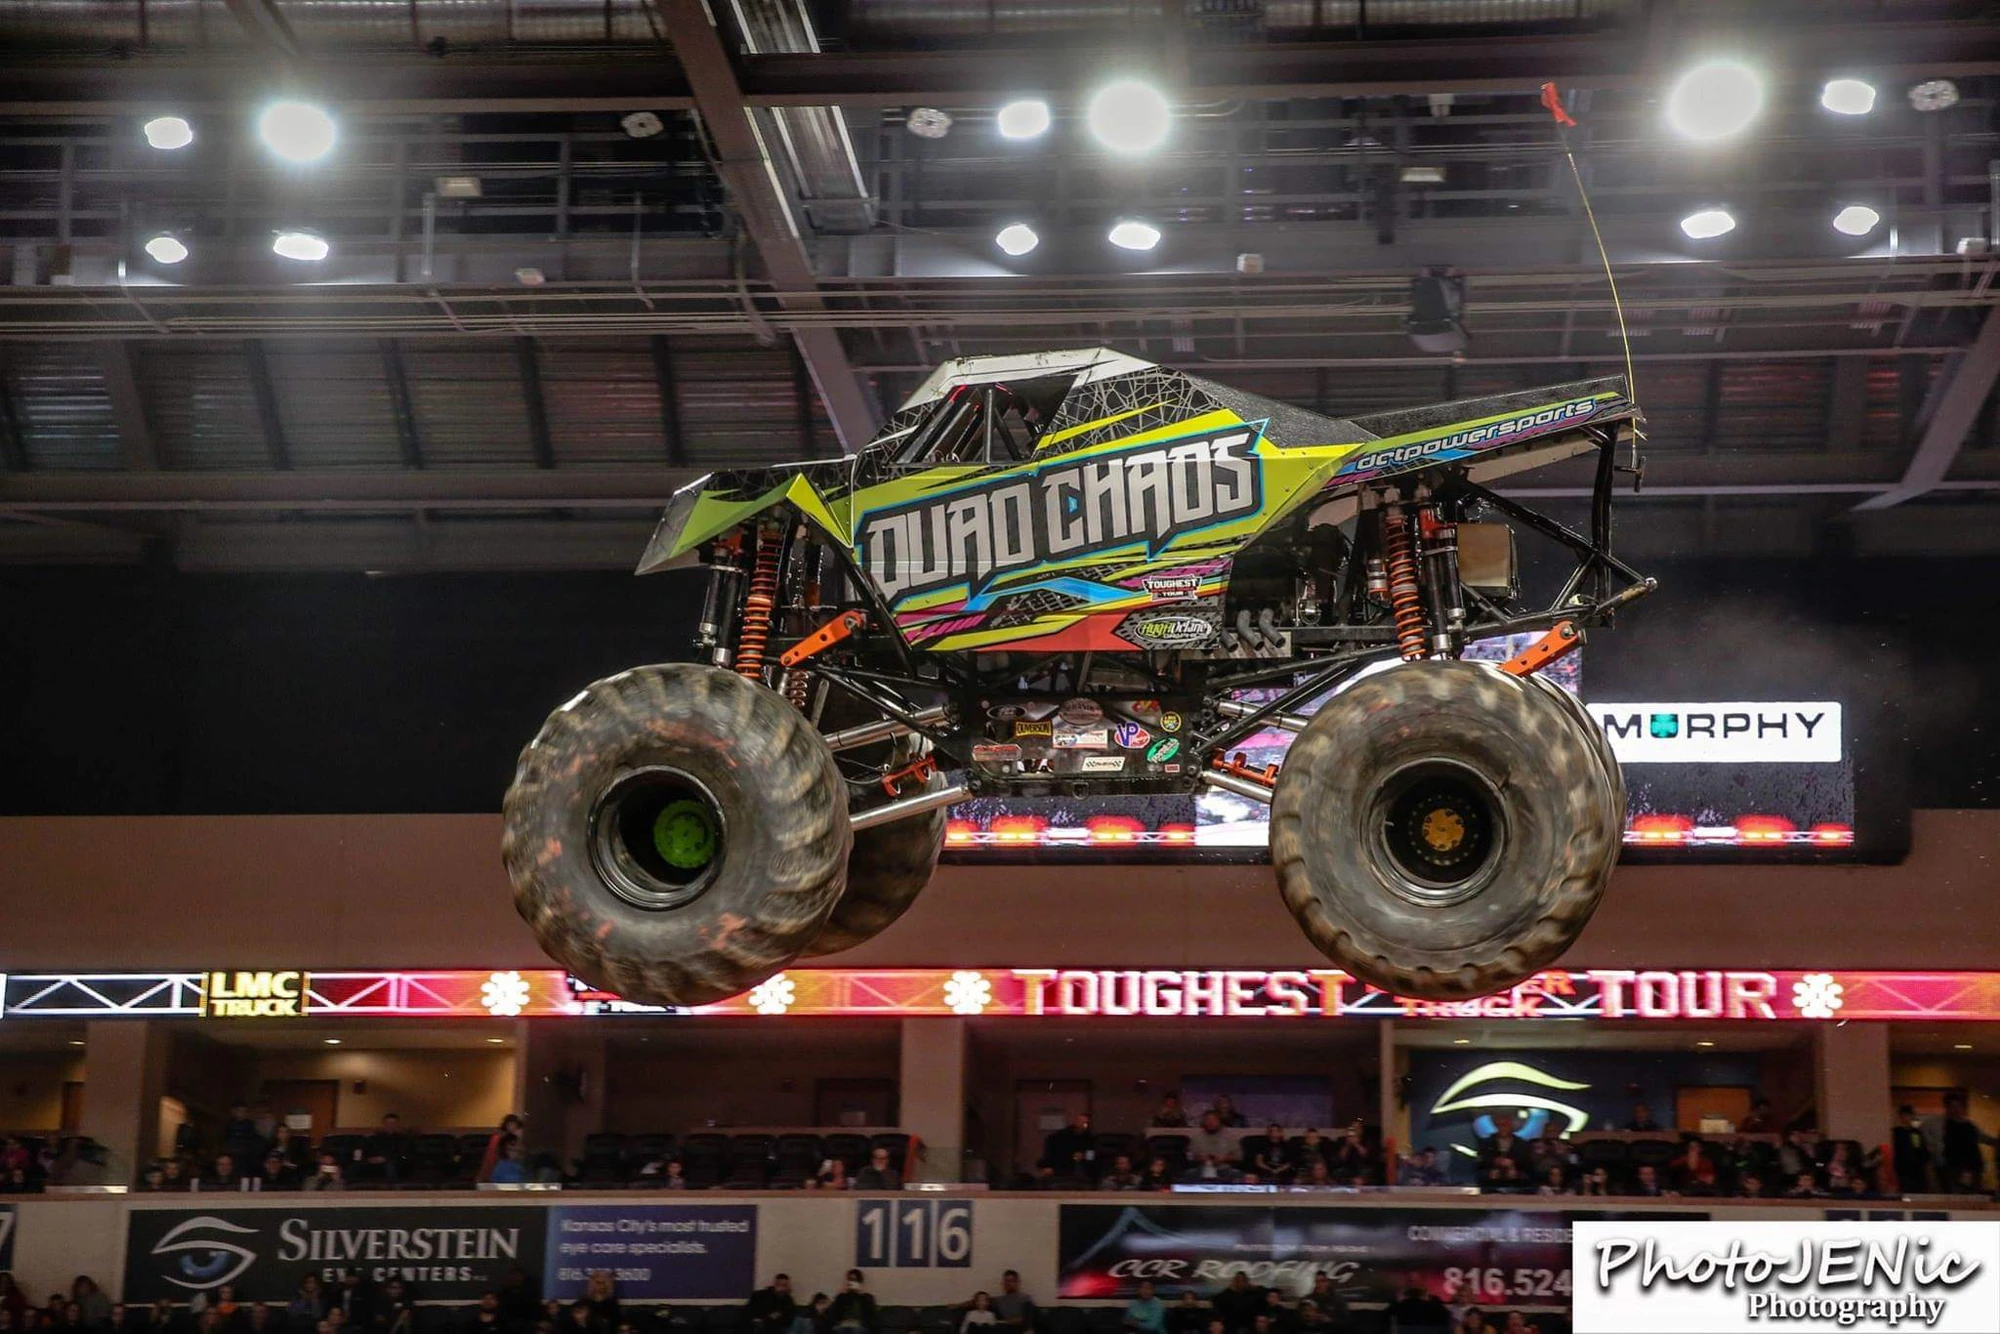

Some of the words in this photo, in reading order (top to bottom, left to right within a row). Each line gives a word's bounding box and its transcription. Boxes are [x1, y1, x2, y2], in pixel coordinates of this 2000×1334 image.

[867, 482, 1035, 601] QUAD
[1042, 433, 1253, 554] CHAOS
[1147, 578, 1198, 589] TOUGHEST
[1117, 722, 1139, 747] VP
[1603, 712, 1825, 739] MURPHY
[211, 972, 299, 998] LMC
[1012, 969, 1356, 1016] TOUGHEST
[1587, 971, 1778, 1018] TOUR
[210, 999, 301, 1016] TRUCK
[561, 1219, 615, 1232] Kansas
[616, 1218, 656, 1234] City's
[659, 1220, 696, 1232] most
[699, 1219, 749, 1232] trusted
[862, 1207, 970, 1261] 116
[560, 1242, 588, 1255] eye
[591, 1242, 627, 1253] care
[322, 1267, 363, 1283] EY
[1108, 1259, 1188, 1279] CCR
[1192, 1260, 1359, 1284] ROOFING
